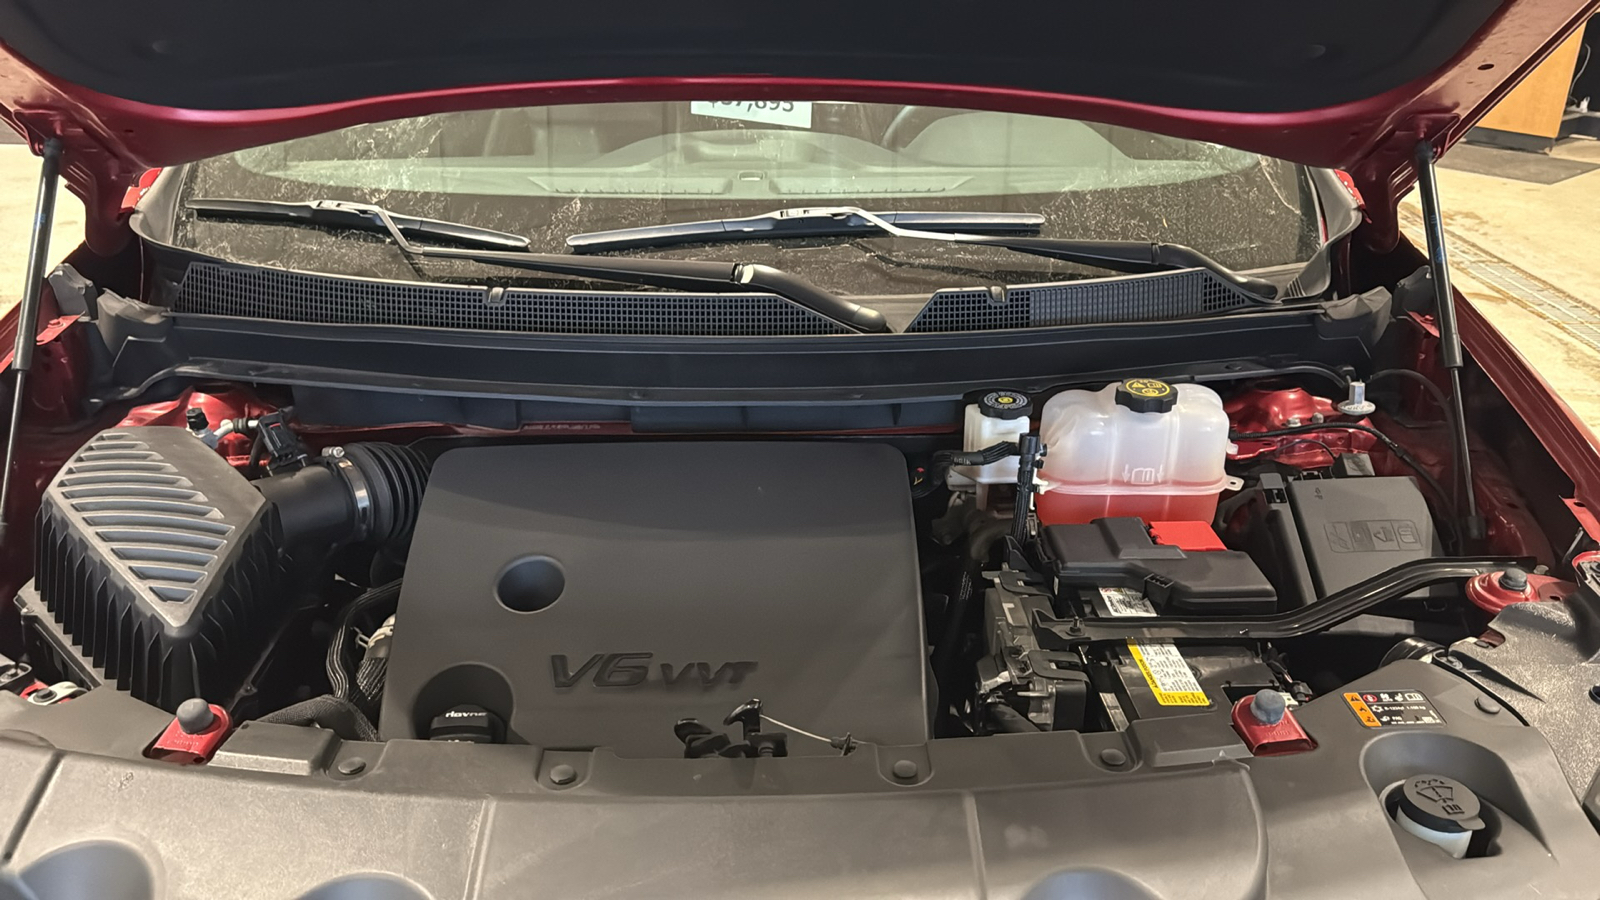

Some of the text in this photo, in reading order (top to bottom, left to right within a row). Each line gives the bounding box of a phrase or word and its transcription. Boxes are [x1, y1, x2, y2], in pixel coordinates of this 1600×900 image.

[709, 101, 794, 112] ,895
[549, 652, 758, 687] V6 VVT
